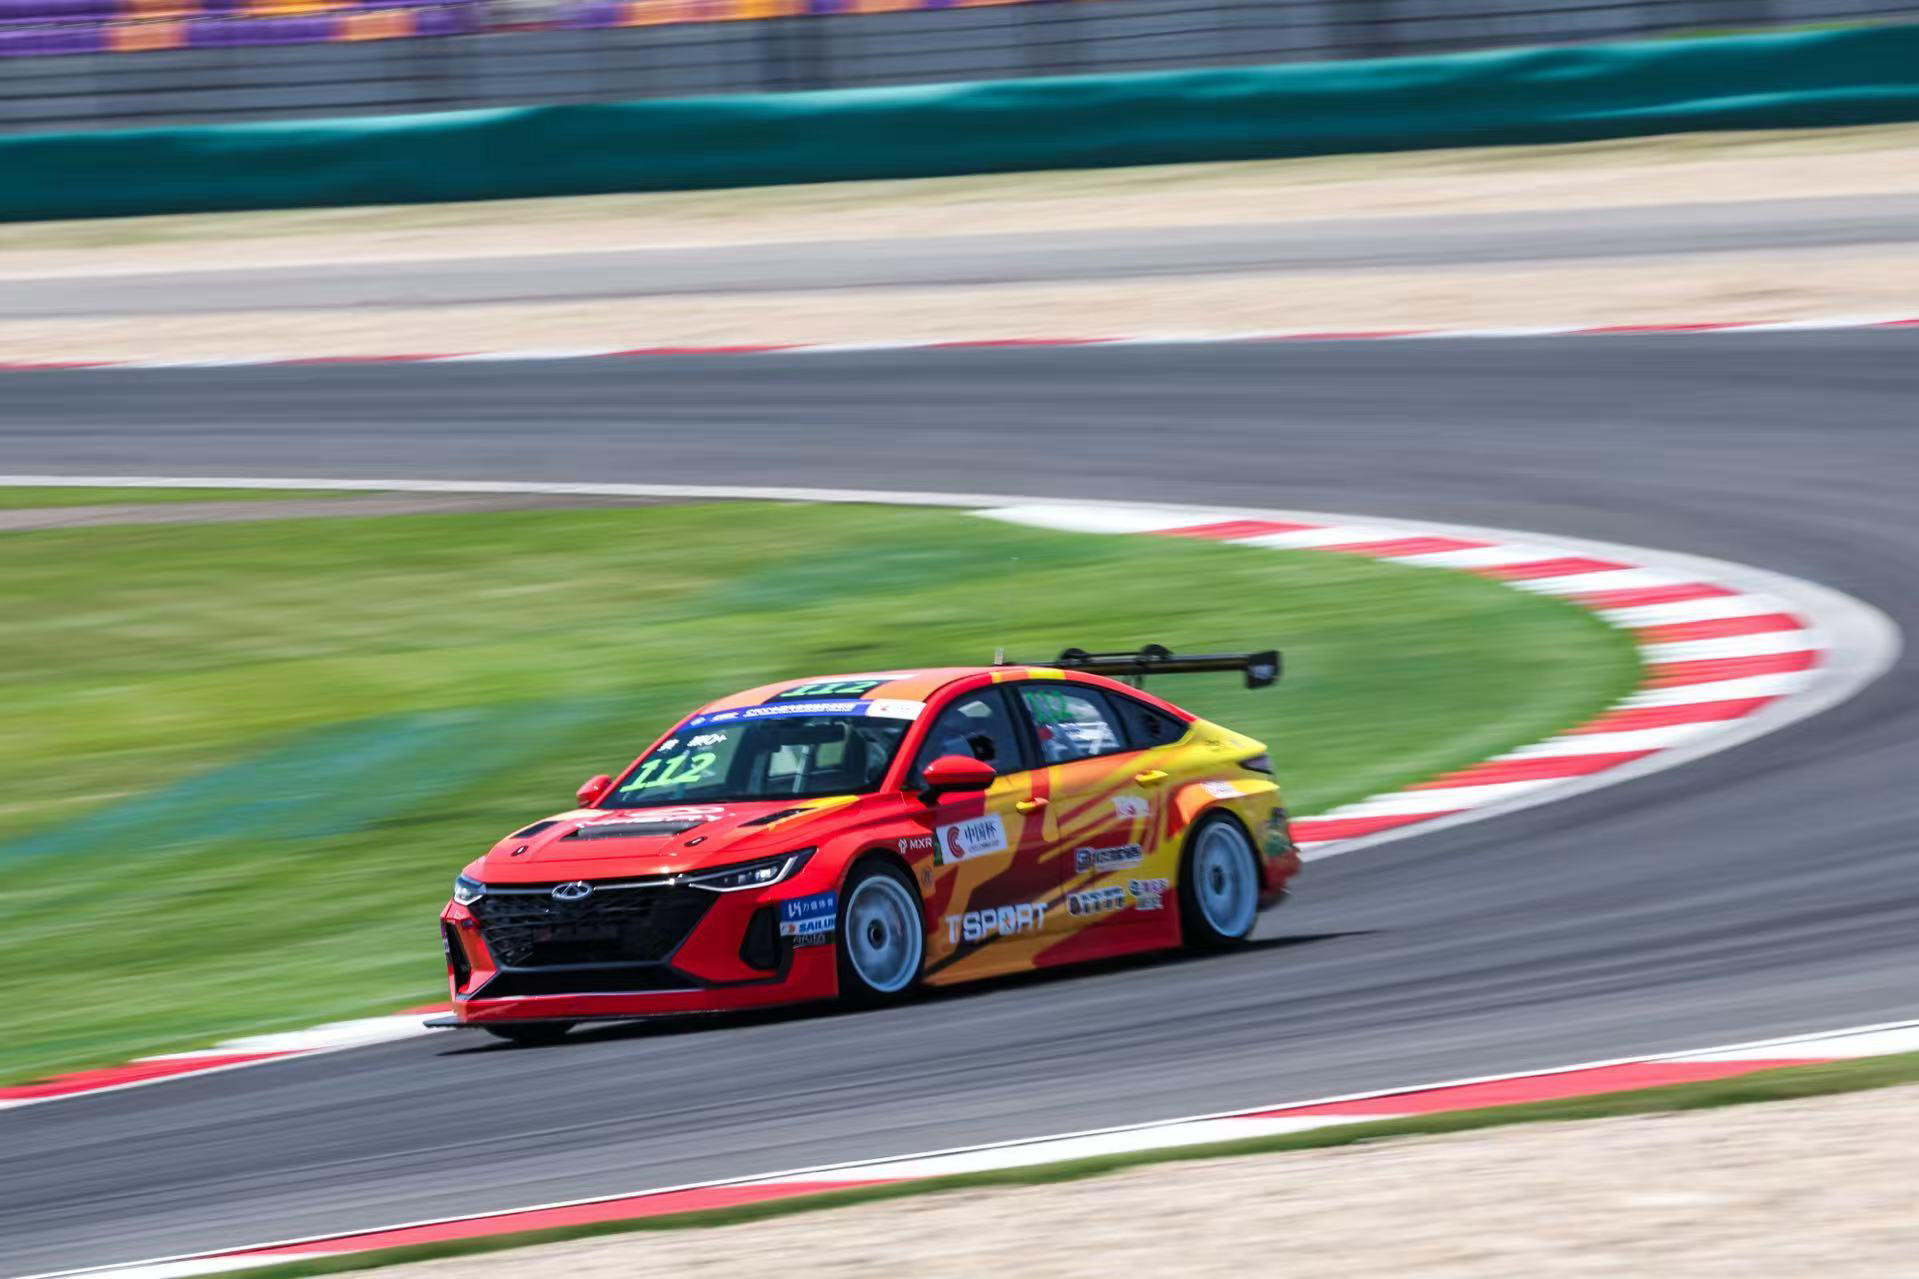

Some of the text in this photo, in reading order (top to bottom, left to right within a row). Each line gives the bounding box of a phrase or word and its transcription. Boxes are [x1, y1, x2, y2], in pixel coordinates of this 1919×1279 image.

[779, 681, 878, 698] 112
[619, 752, 716, 793] 112
[909, 837, 933, 850] MXR
[945, 902, 1048, 944] TSPORT
